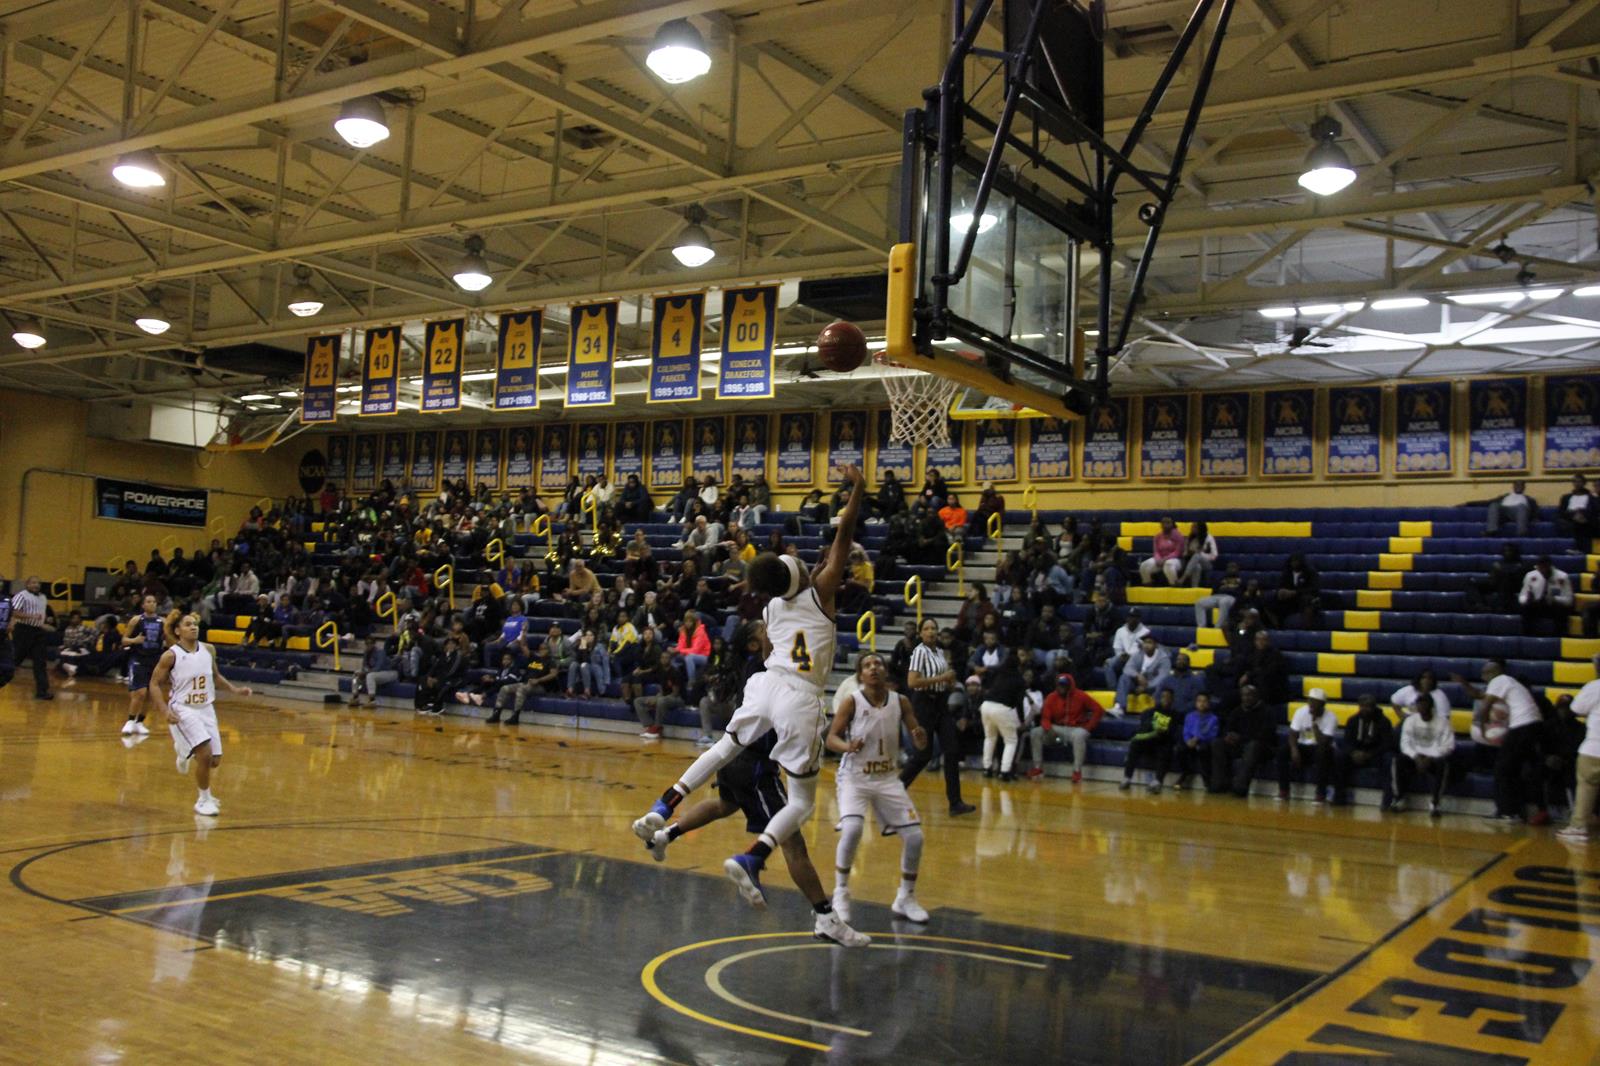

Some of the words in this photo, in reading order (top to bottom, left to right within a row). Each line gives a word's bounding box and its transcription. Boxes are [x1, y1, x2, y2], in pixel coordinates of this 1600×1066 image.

[671, 329, 682, 348] 4
[736, 322, 761, 343] 00
[510, 342, 527, 361] 12
[582, 335, 602, 355] 34
[373, 353, 390, 371] 40
[434, 348, 453, 366] 22
[314, 362, 330, 379] 22
[124, 491, 205, 510] POWERADE
[791, 630, 814, 672] 4
[192, 675, 207, 691] 12
[878, 738, 884, 757] 1
